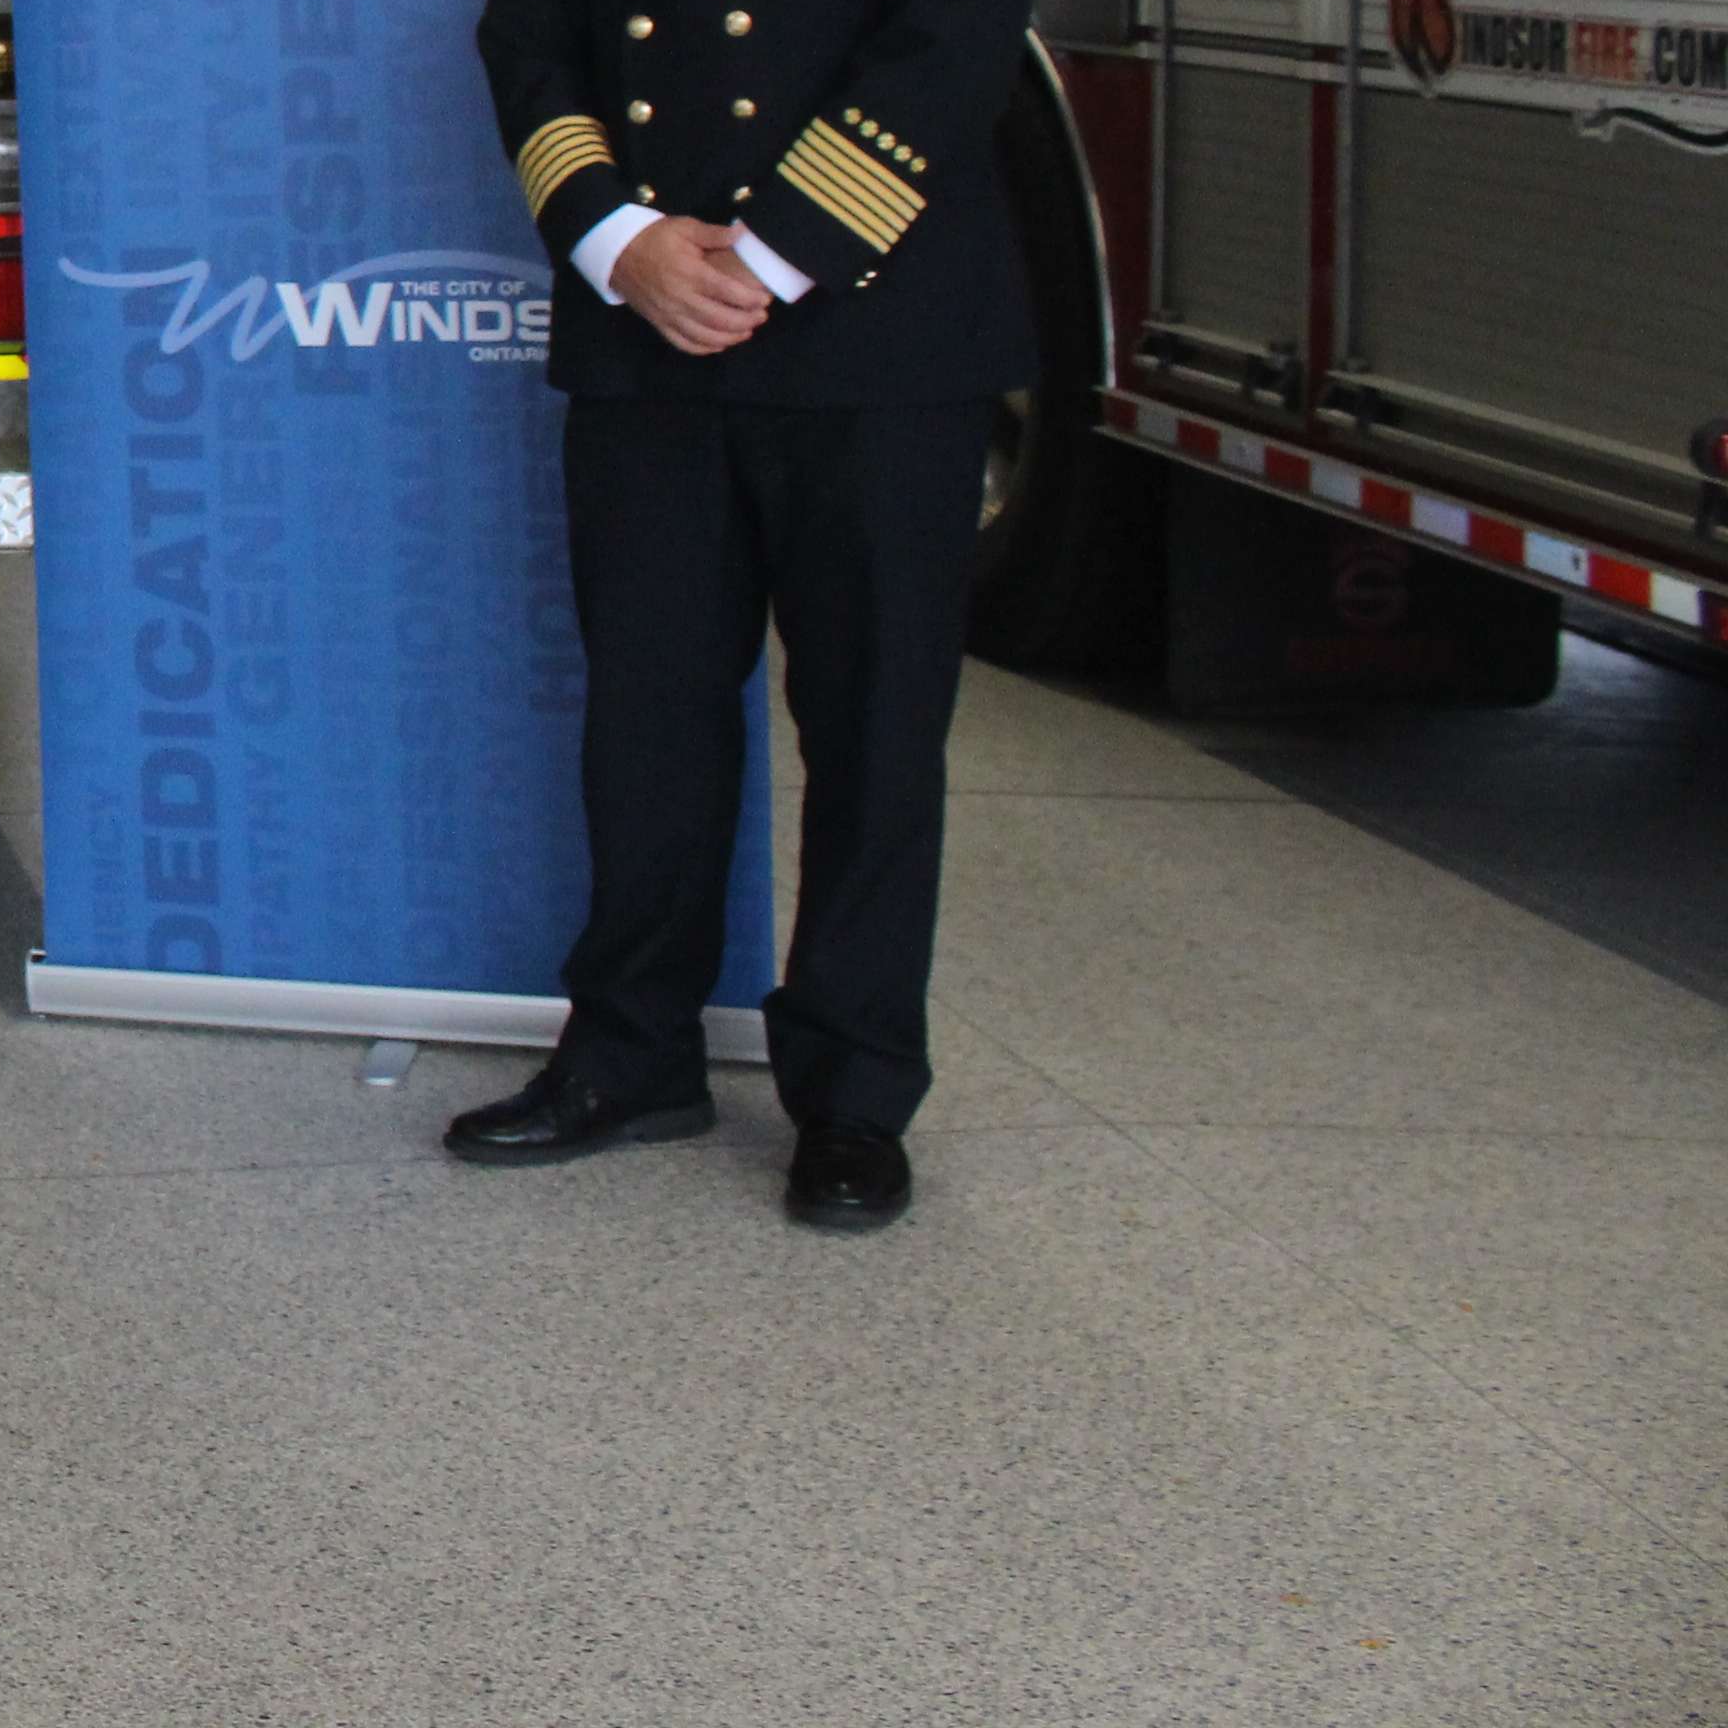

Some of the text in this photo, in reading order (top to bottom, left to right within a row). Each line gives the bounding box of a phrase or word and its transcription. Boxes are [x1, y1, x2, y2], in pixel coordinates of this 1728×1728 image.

[399, 280, 527, 296] THE CITY OF
